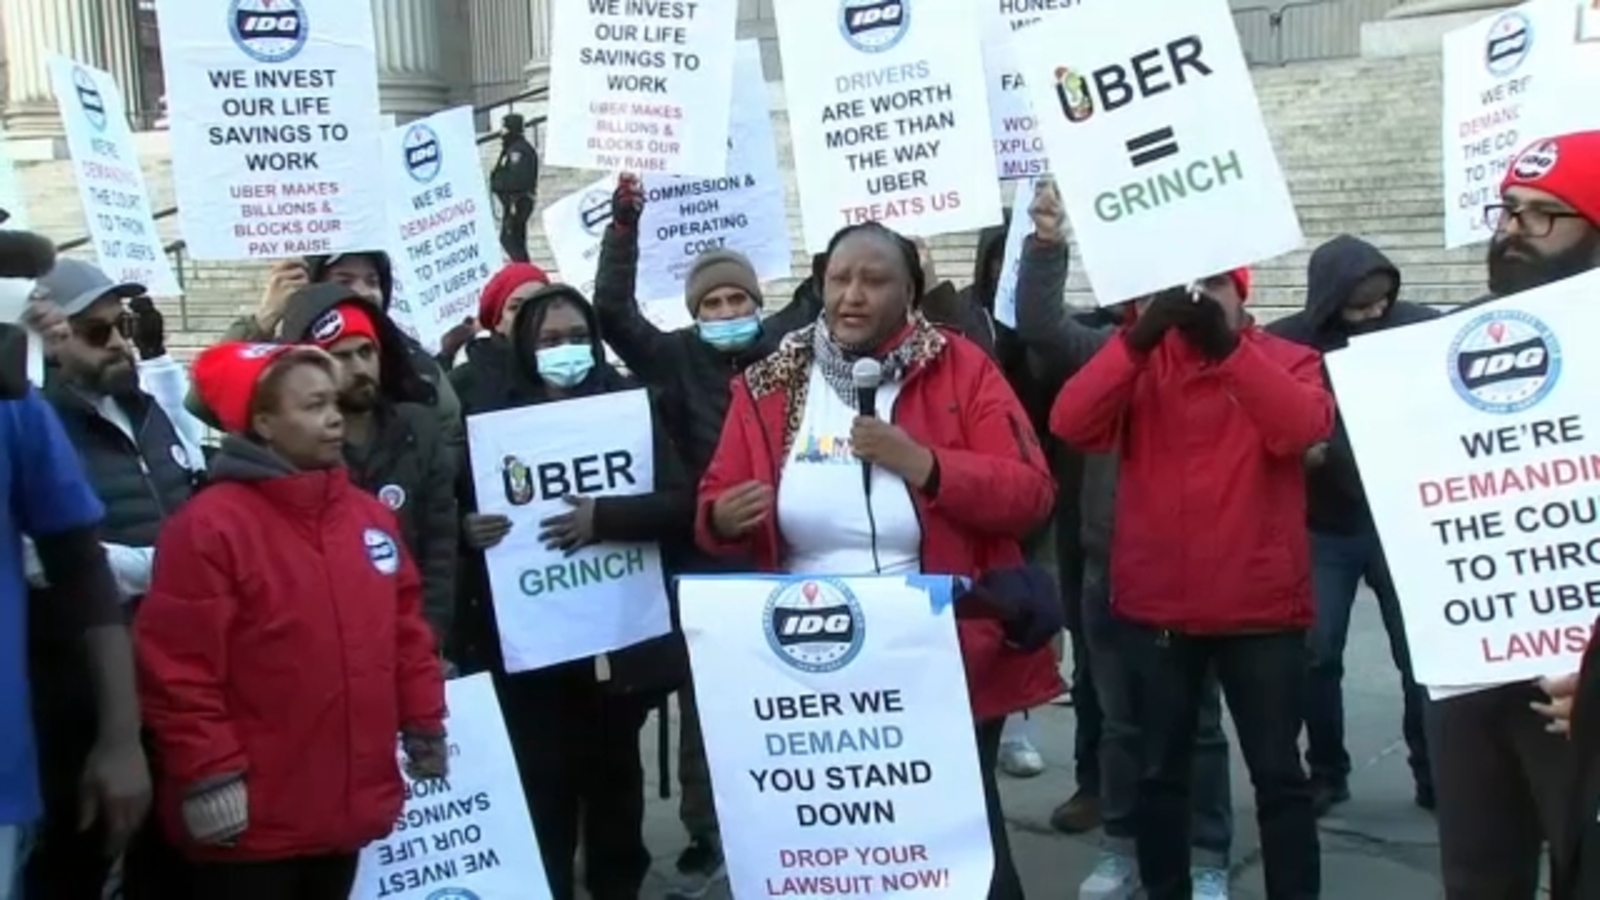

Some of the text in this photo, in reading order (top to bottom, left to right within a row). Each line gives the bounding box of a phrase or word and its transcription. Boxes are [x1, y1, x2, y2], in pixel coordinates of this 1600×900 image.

[244, 16, 297, 31] IDG
[588, 0, 698, 20] WE INVEST
[851, 4, 900, 26] IDG
[595, 23, 687, 44] OUR LIFE
[580, 48, 700, 71] SAVINGS TO
[208, 69, 336, 88] WE INVEST
[607, 75, 668, 94] WORK
[835, 59, 930, 93] DRIVERS
[1055, 34, 1213, 123] UBER
[222, 97, 331, 116] OUR LIFE
[589, 101, 683, 120] UBER MAKES
[821, 83, 952, 124] ARE WORTH
[209, 123, 349, 146] SAVINGS TO
[826, 111, 956, 149] MORE THAN
[1002, 115, 1038, 132] WO
[587, 137, 680, 154] BLOCKS OUR
[845, 140, 941, 173] THE WAY
[1463, 138, 1490, 160] THE
[245, 152, 319, 171] WORK
[1465, 165, 1485, 183] TO
[230, 182, 339, 199] UBER MAKES
[643, 173, 755, 203] OMMISSION &
[866, 169, 927, 195] UBER
[1094, 150, 1243, 223] GRINCH
[241, 200, 333, 218] BILLIONS &
[412, 183, 452, 211] WE'RE
[679, 199, 719, 216] HIGH
[841, 191, 961, 225] TREATS US
[234, 219, 341, 237] BLOCKS OUR
[399, 199, 476, 240] DEMANDING
[657, 214, 749, 241] OPERATING
[248, 239, 331, 256] PAY RAISE
[407, 220, 477, 262] THE COURT
[415, 244, 479, 281] TO THROW
[419, 284, 441, 307] OUT
[444, 263, 488, 294] UBER'S
[1469, 347, 1545, 379] IDG
[1460, 416, 1584, 459] WE'RE
[502, 449, 636, 505] UBER
[1431, 512, 1506, 545] THE
[519, 547, 645, 596] GRINCH
[1446, 538, 1600, 584] TO THRO
[1444, 581, 1600, 626] OUT UBE
[783, 614, 850, 635] IDG
[754, 689, 904, 721] UBER WE
[765, 725, 904, 756] DEMAND
[749, 759, 932, 793] YOU STAND
[396, 791, 491, 832] SAVINGS
[797, 800, 895, 827] DOWN
[378, 824, 481, 866] OUR LIFE
[780, 844, 928, 868] DROP YOUR
[377, 848, 500, 898] WE INVEST
[766, 869, 949, 896] LAWSUIT NOW!
